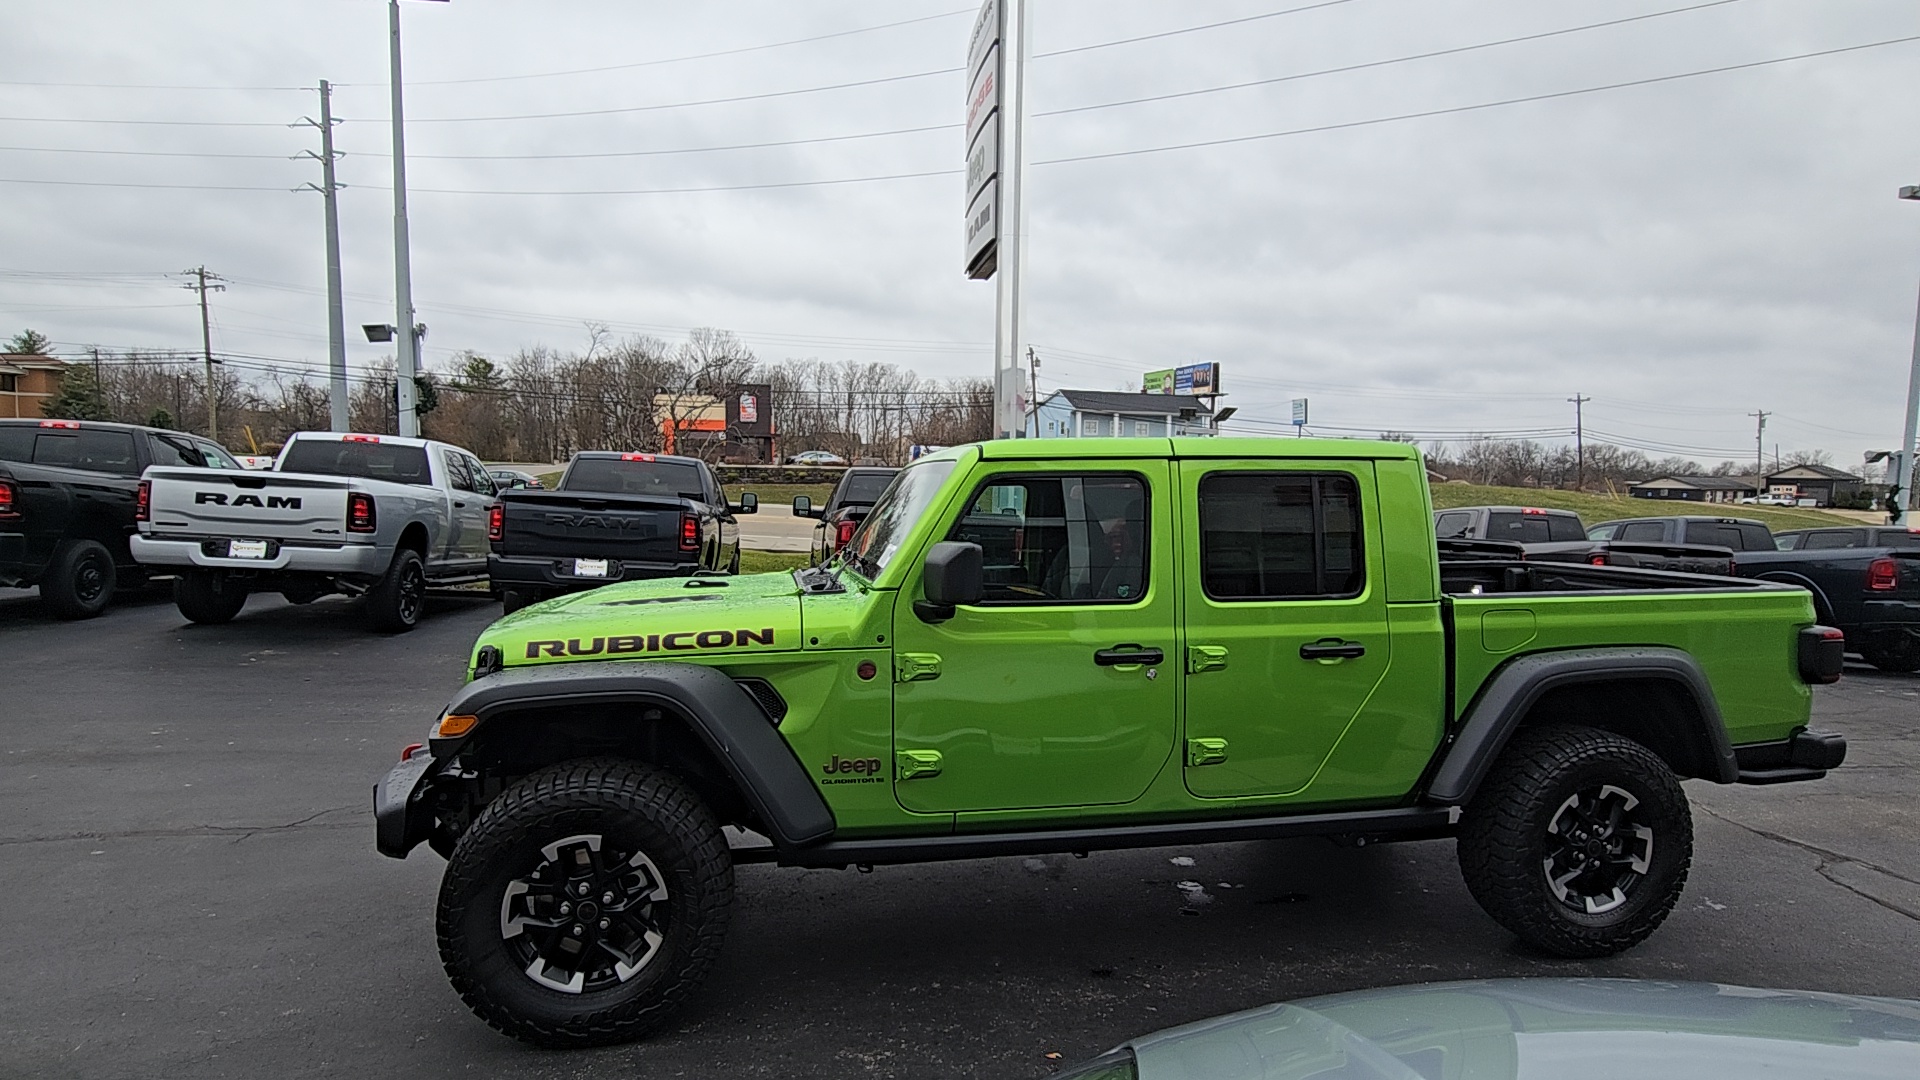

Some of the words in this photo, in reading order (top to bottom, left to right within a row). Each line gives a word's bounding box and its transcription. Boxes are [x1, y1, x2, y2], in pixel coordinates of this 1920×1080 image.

[194, 491, 302, 510] RAM
[545, 513, 640, 529] RAM
[525, 627, 775, 659] RUBICON
[822, 753, 881, 776] Jeep
[821, 777, 875, 785] GLADIATOR
